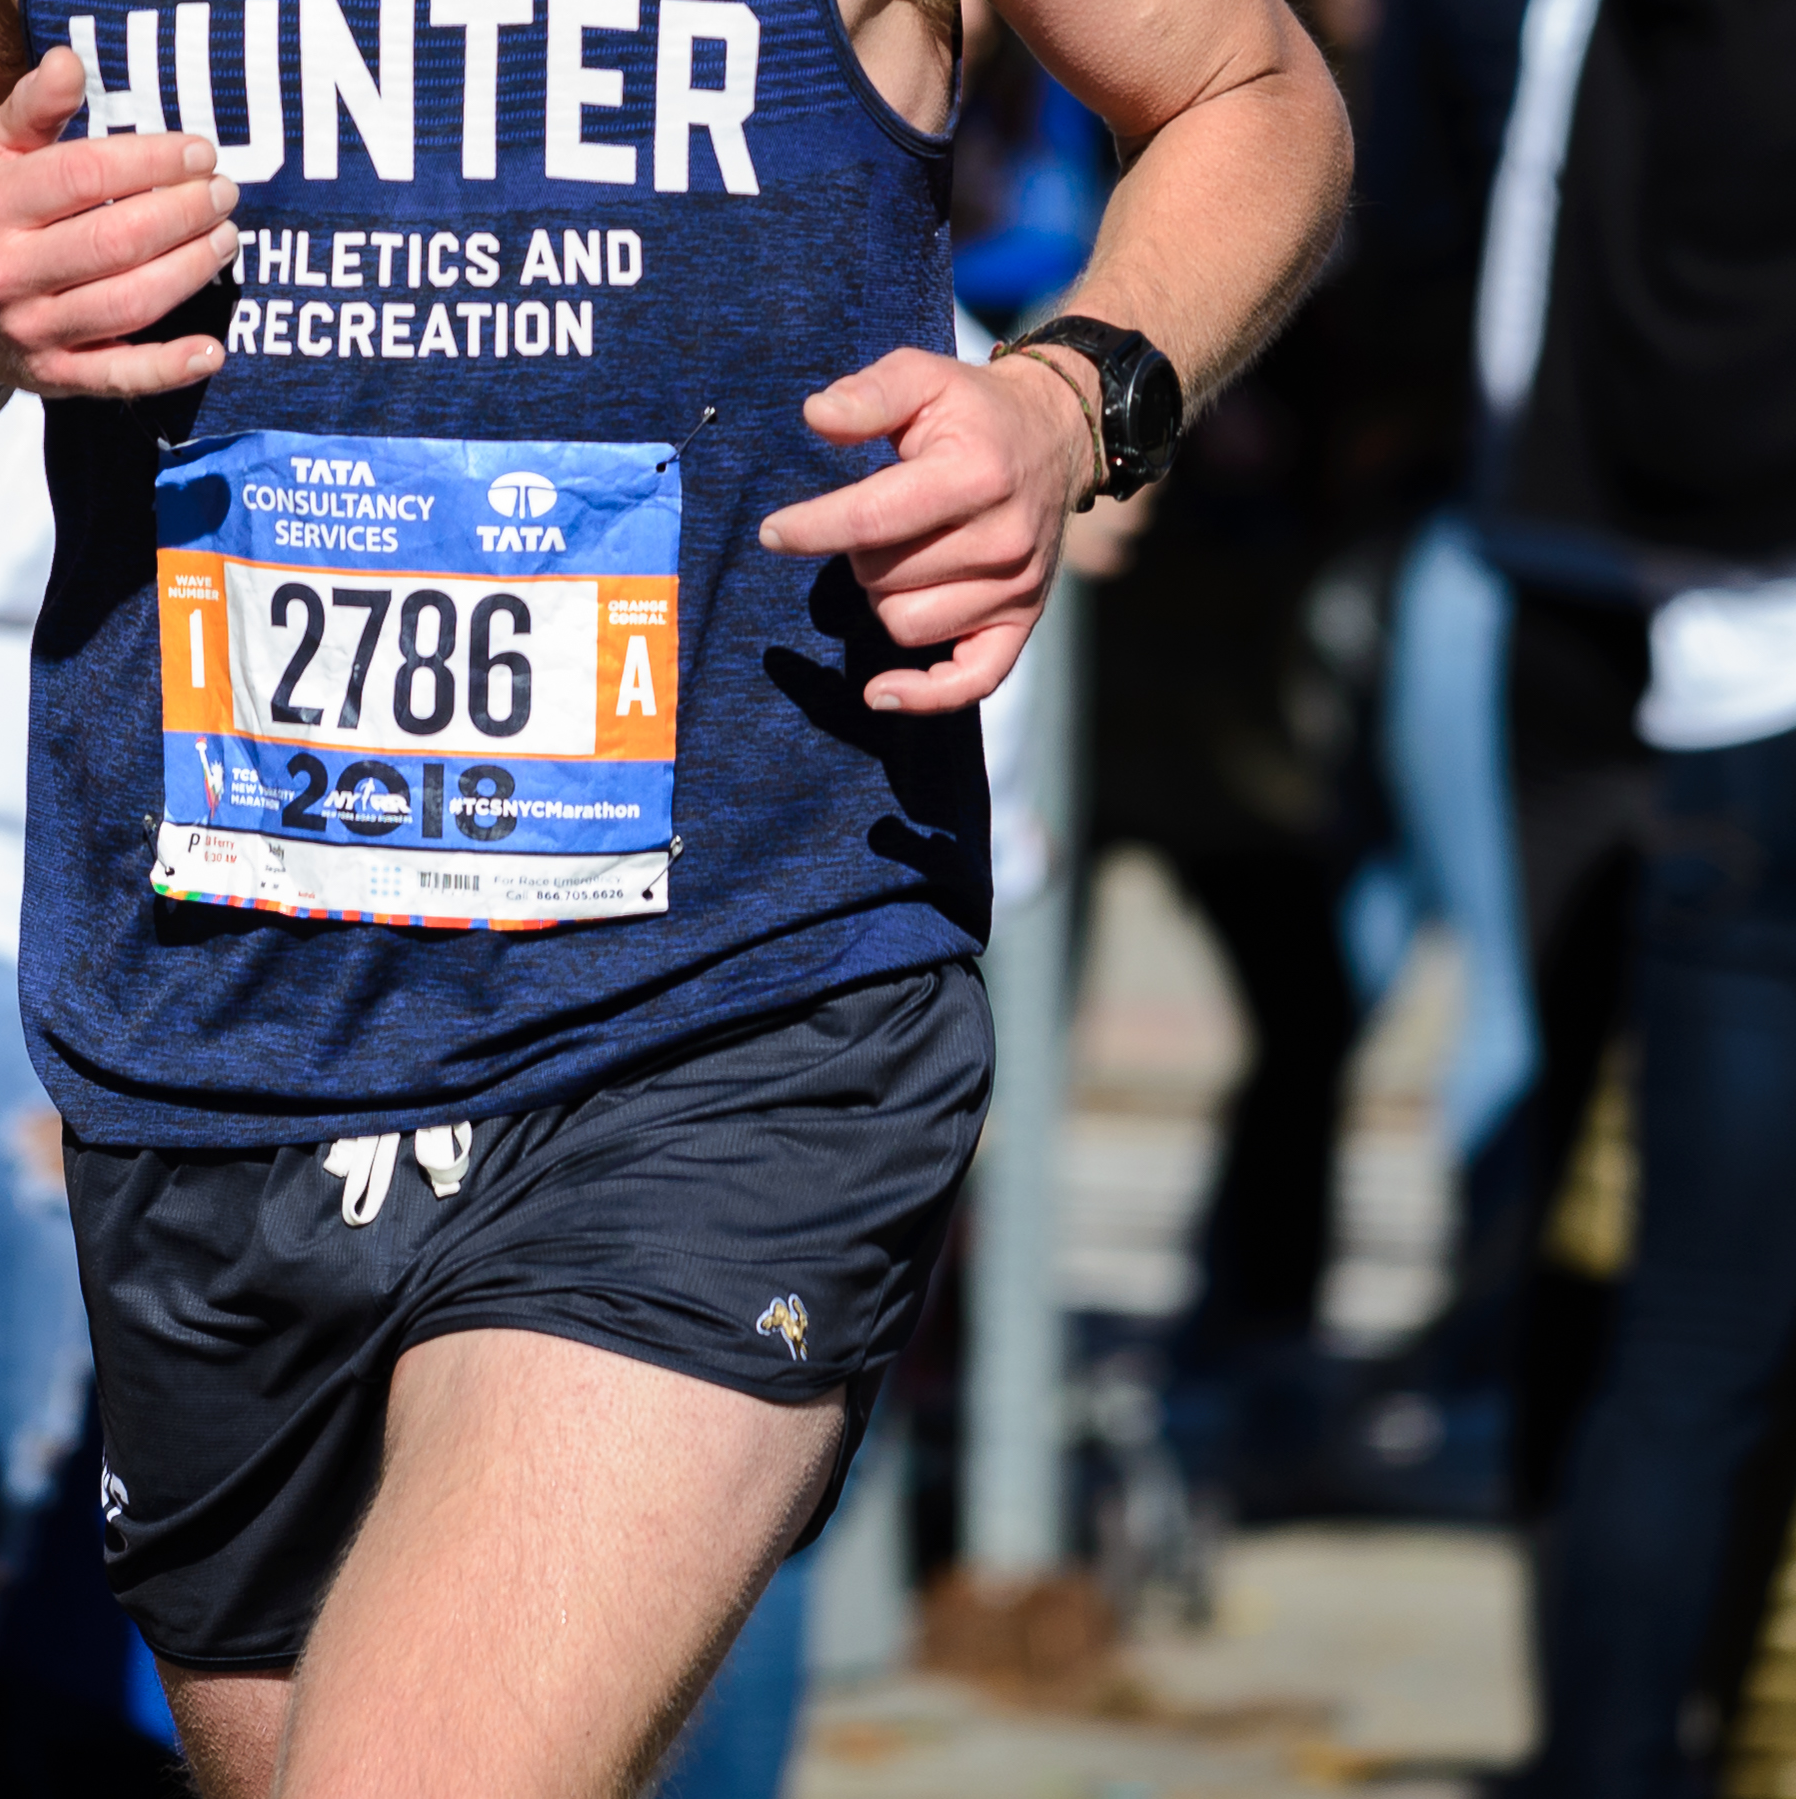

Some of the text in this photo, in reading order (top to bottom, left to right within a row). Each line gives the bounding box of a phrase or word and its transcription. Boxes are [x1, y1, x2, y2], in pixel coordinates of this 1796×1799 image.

[209, 229, 644, 289] THLETICS AND
[227, 300, 594, 358] RECREATION
[290, 457, 376, 486] TATA
[242, 483, 436, 522] CONSULTANCY
[274, 521, 399, 552] SERVICES
[476, 525, 567, 552] TATA
[167, 586, 220, 602] NUMBER
[174, 574, 213, 588] WAVE
[608, 600, 669, 613] ORANGE
[608, 613, 667, 626] CORRAL
[188, 608, 206, 689] 1
[269, 581, 533, 738] 2786
[616, 635, 658, 716] A
[231, 782, 257, 795] NEW
[232, 767, 258, 783] TCS
[281, 752, 517, 842] 2018
[449, 796, 640, 820] #TCSNYCMarathon
[494, 875, 514, 886] For
[519, 875, 549, 886] Race
